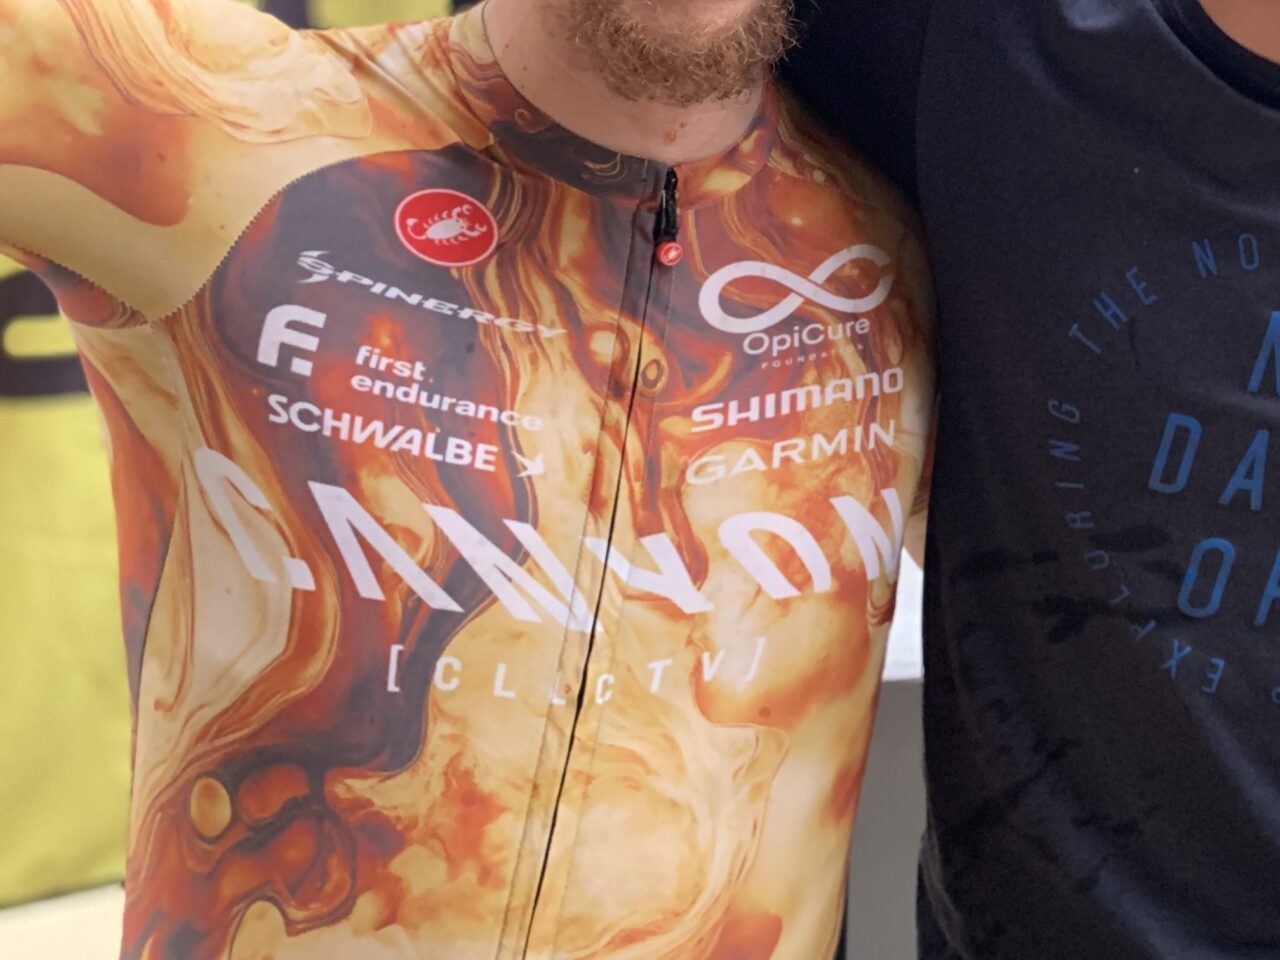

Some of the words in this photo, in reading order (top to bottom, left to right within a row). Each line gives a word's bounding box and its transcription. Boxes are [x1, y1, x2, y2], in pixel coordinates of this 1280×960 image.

[297, 250, 568, 338] SPINERGY
[1068, 267, 1157, 354] THE
[355, 345, 427, 381] first
[742, 317, 871, 357] OpiCure
[760, 343, 864, 370] FOUNDATON
[267, 393, 500, 472] SCHWALBE
[350, 374, 545, 431] endurance
[690, 366, 905, 433] SHIMANO
[685, 419, 896, 485] GARMIN
[194, 446, 904, 634] CANYON
[1046, 398, 1226, 696] EXPLORING
